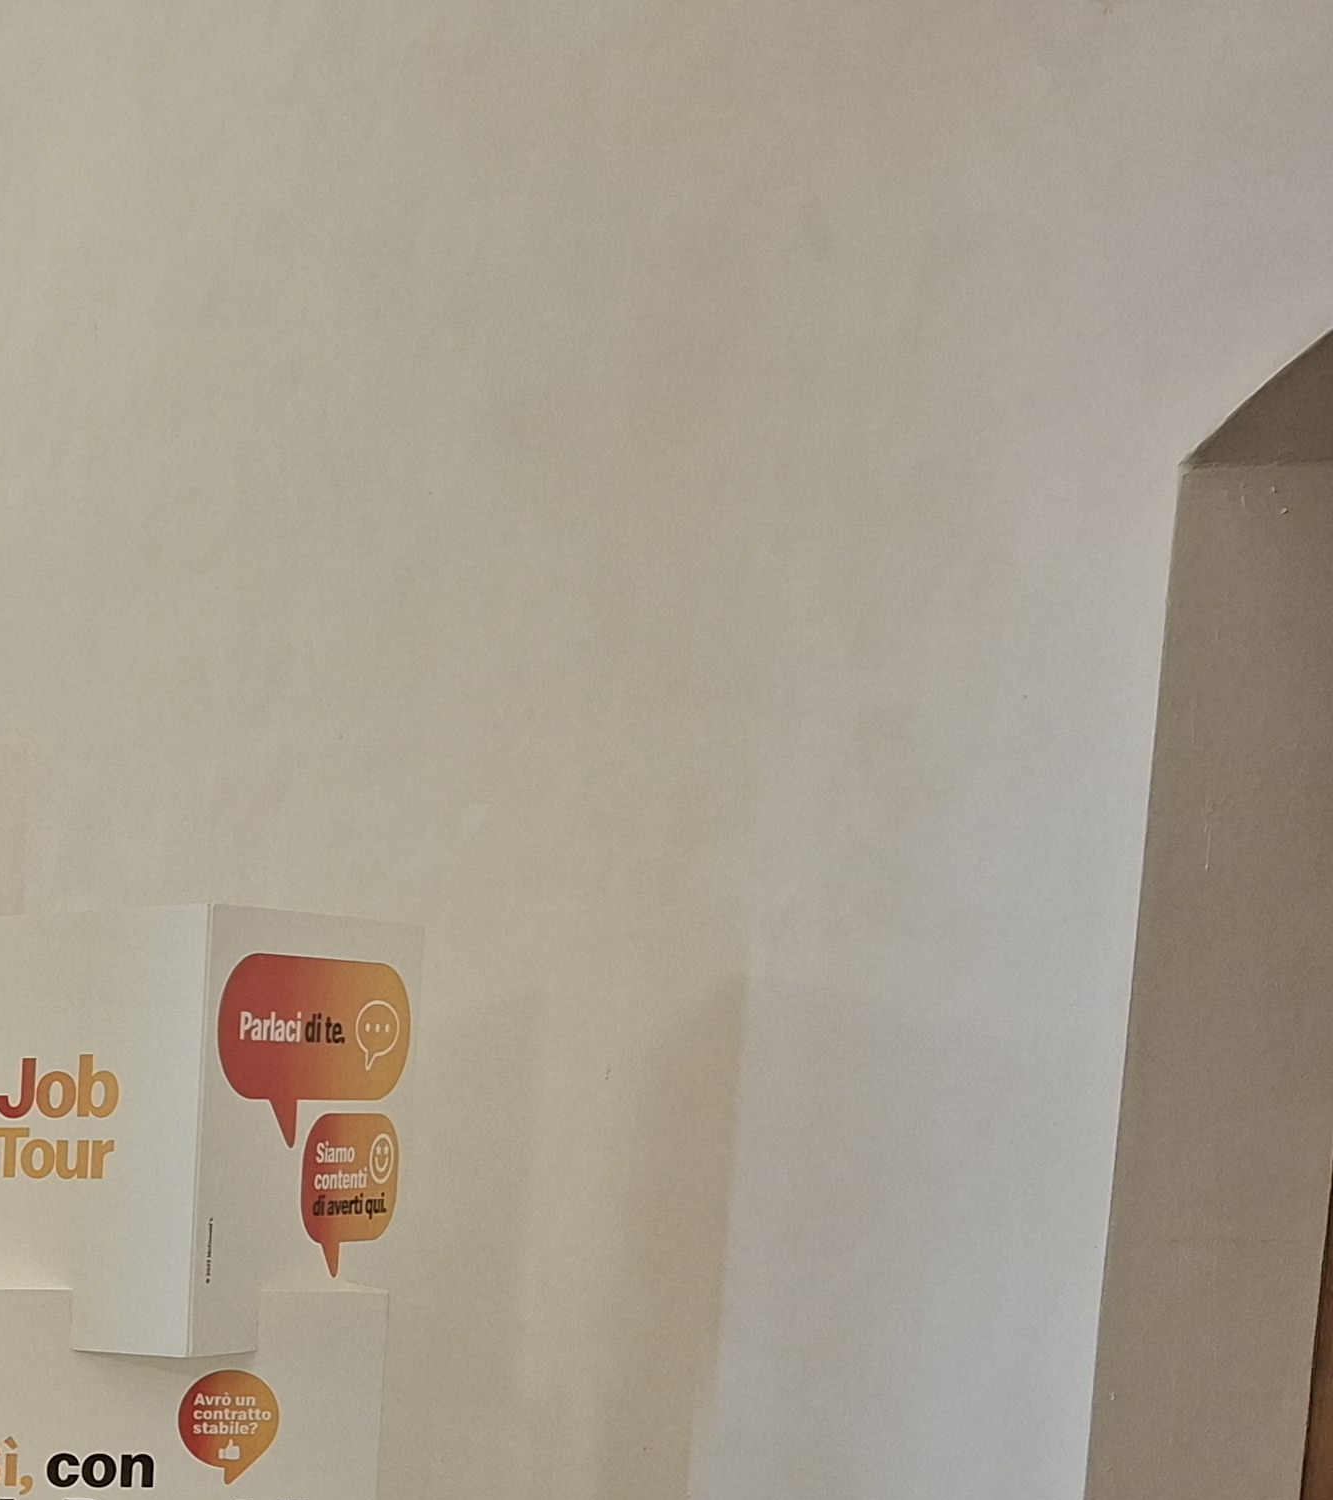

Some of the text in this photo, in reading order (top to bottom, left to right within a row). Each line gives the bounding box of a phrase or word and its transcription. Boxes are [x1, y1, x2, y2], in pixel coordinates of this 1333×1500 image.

[239, 1011, 345, 1045] Parlaci di te.
[315, 1140, 355, 1164] Siamo
[314, 1166, 368, 1190] contenti
[313, 1192, 387, 1220] di averti qui.
[193, 1391, 256, 1407] Avrò un
[193, 1407, 273, 1421] contratto
[193, 1422, 259, 1436] stabile?
[46, 1452, 155, 1489] con
